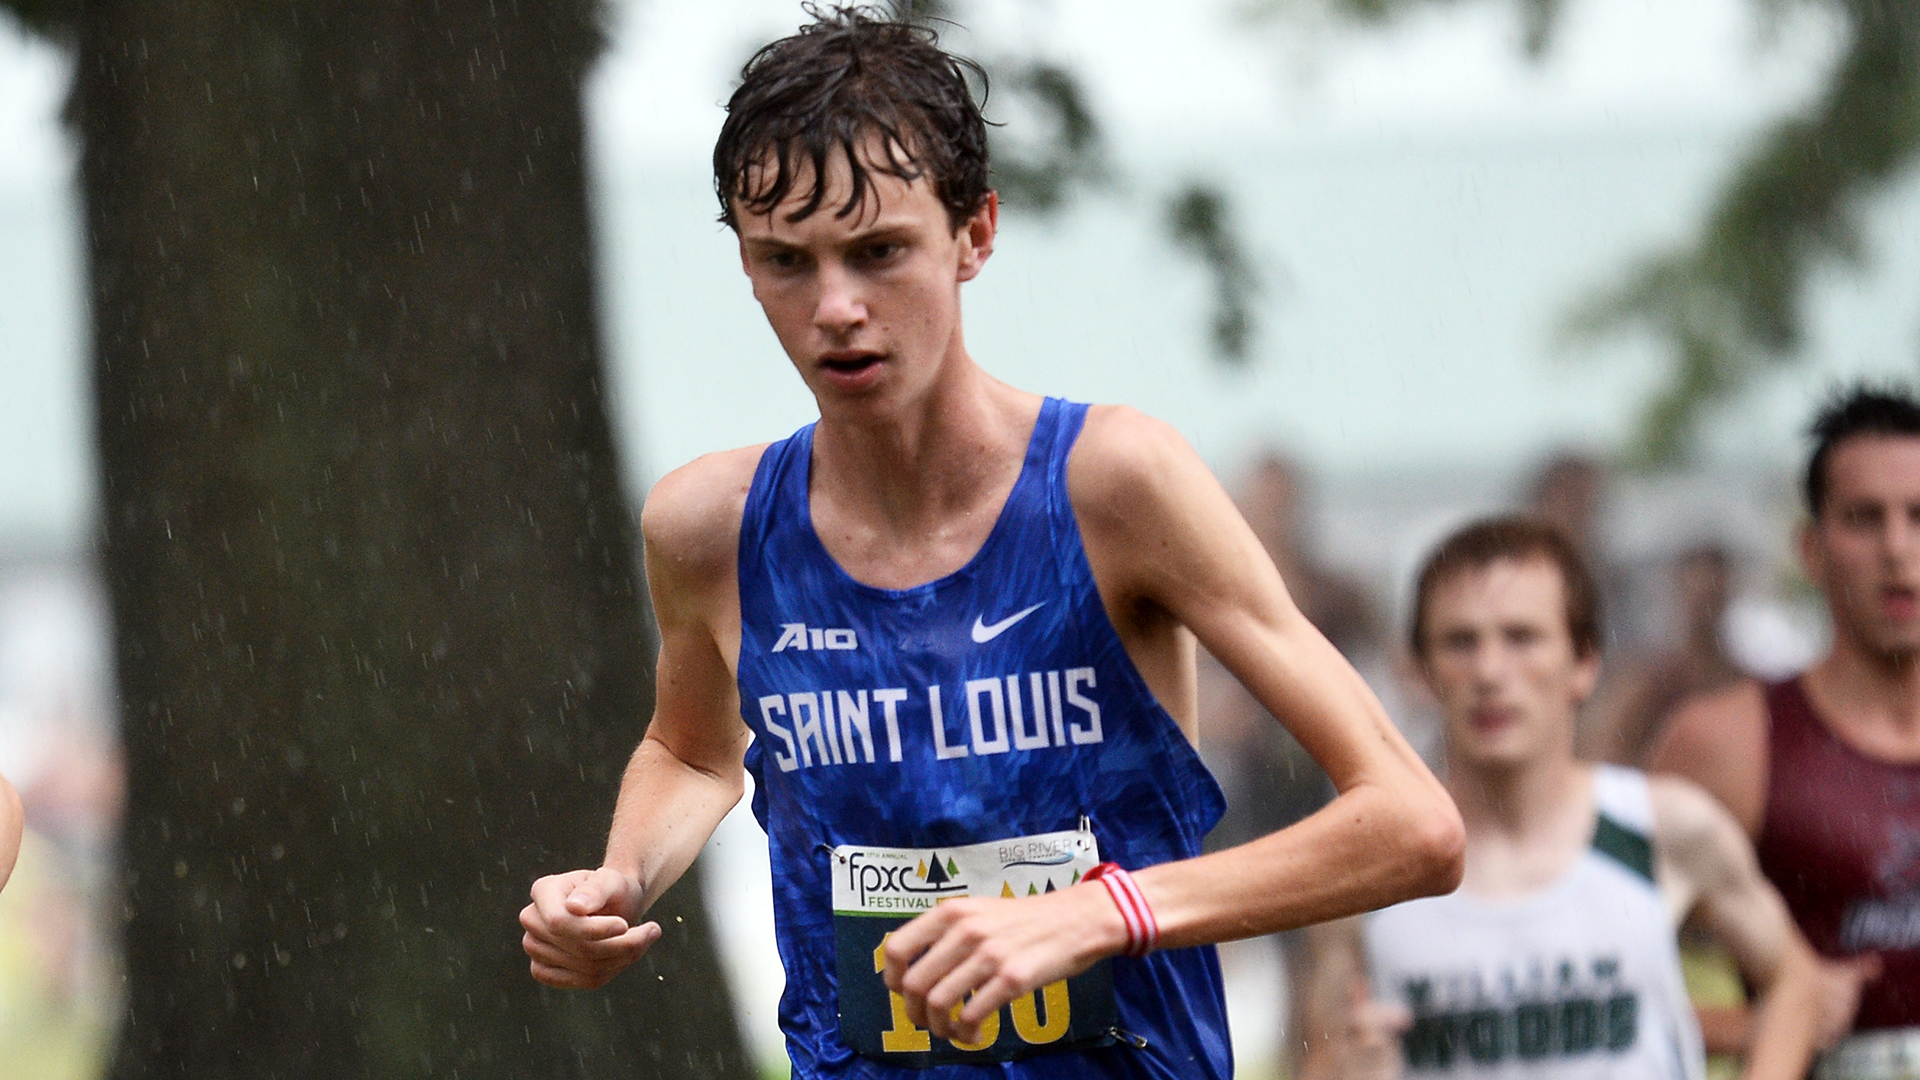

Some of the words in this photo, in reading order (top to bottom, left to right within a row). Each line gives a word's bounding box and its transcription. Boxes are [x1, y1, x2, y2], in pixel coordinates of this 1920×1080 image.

[772, 622, 858, 653] A10
[759, 687, 908, 773] SAINT
[928, 666, 1104, 760] LOUIS
[999, 845, 1025, 859] BIG
[868, 896, 932, 909] FESTIVAL
